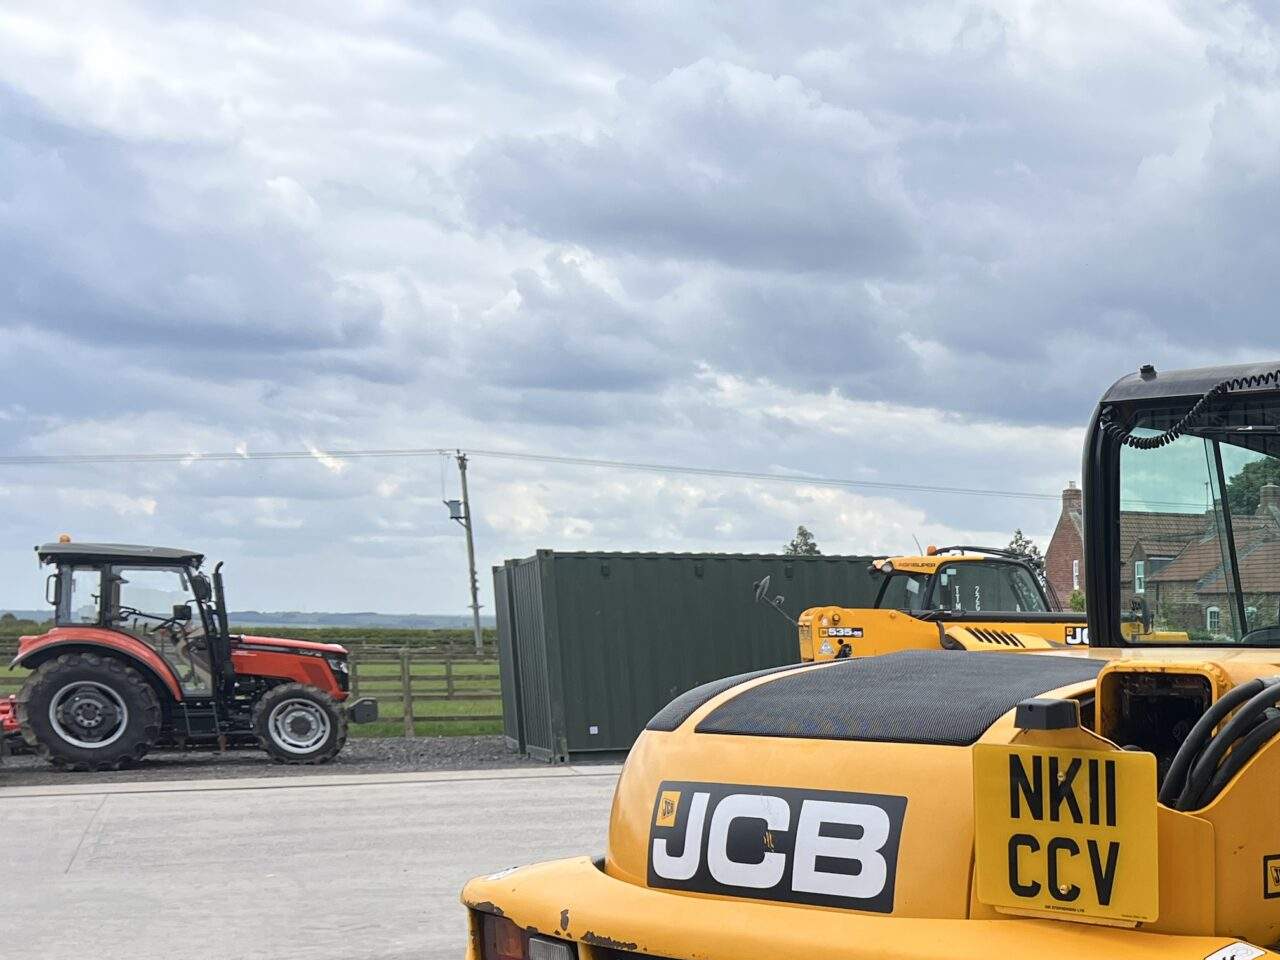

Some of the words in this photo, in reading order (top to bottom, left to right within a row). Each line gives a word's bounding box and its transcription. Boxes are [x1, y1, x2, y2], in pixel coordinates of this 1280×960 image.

[1009, 753, 1117, 827] NK11
[652, 791, 891, 899] JCB
[1008, 833, 1121, 906] CCV
